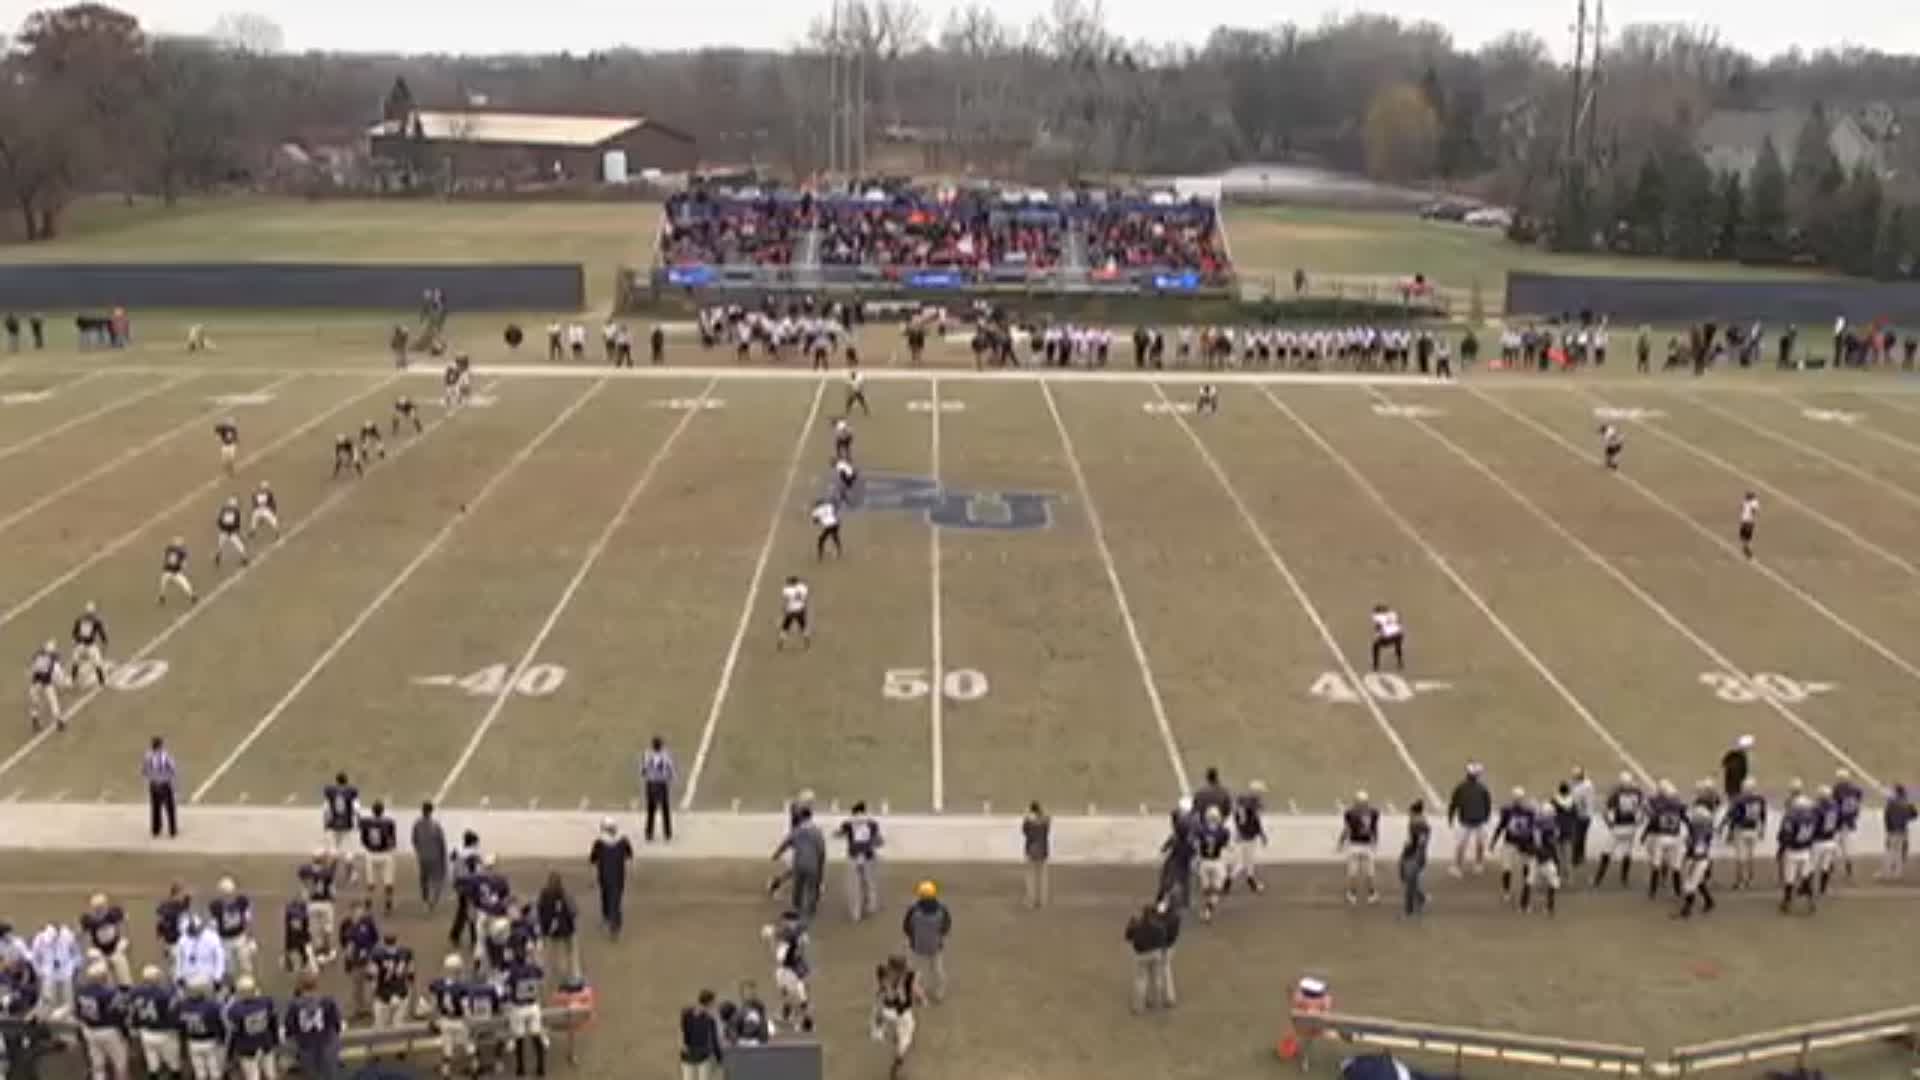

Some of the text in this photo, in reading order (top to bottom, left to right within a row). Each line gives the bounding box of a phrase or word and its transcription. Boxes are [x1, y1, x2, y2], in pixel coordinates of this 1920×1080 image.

[455, 662, 569, 697] 40
[882, 667, 988, 700] 50
[1310, 670, 1415, 703] 40
